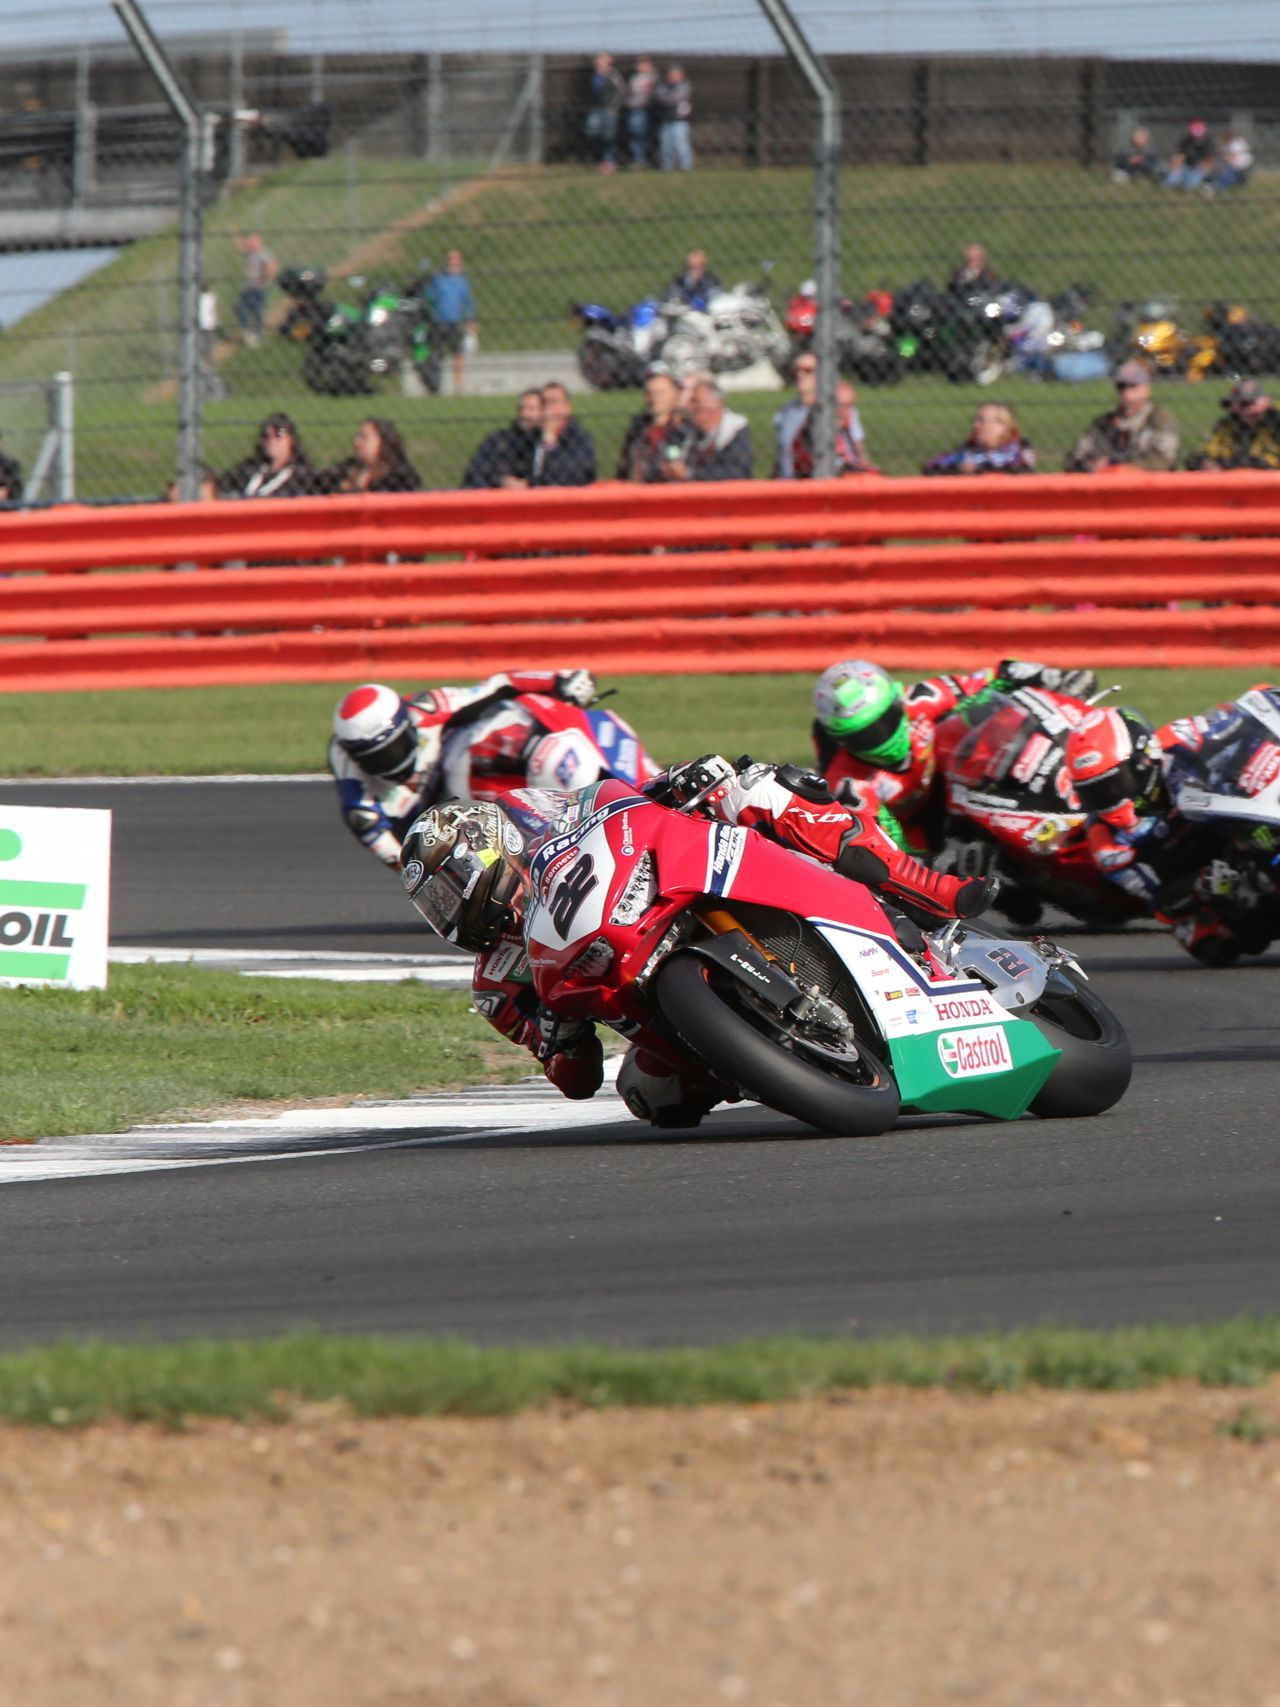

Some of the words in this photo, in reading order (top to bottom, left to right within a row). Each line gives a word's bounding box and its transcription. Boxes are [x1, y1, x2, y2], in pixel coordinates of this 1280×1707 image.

[713, 838, 729, 875] Honda
[548, 853, 600, 942] 22
[934, 998, 994, 1021] HONDA
[957, 1031, 1008, 1071] Castrol
